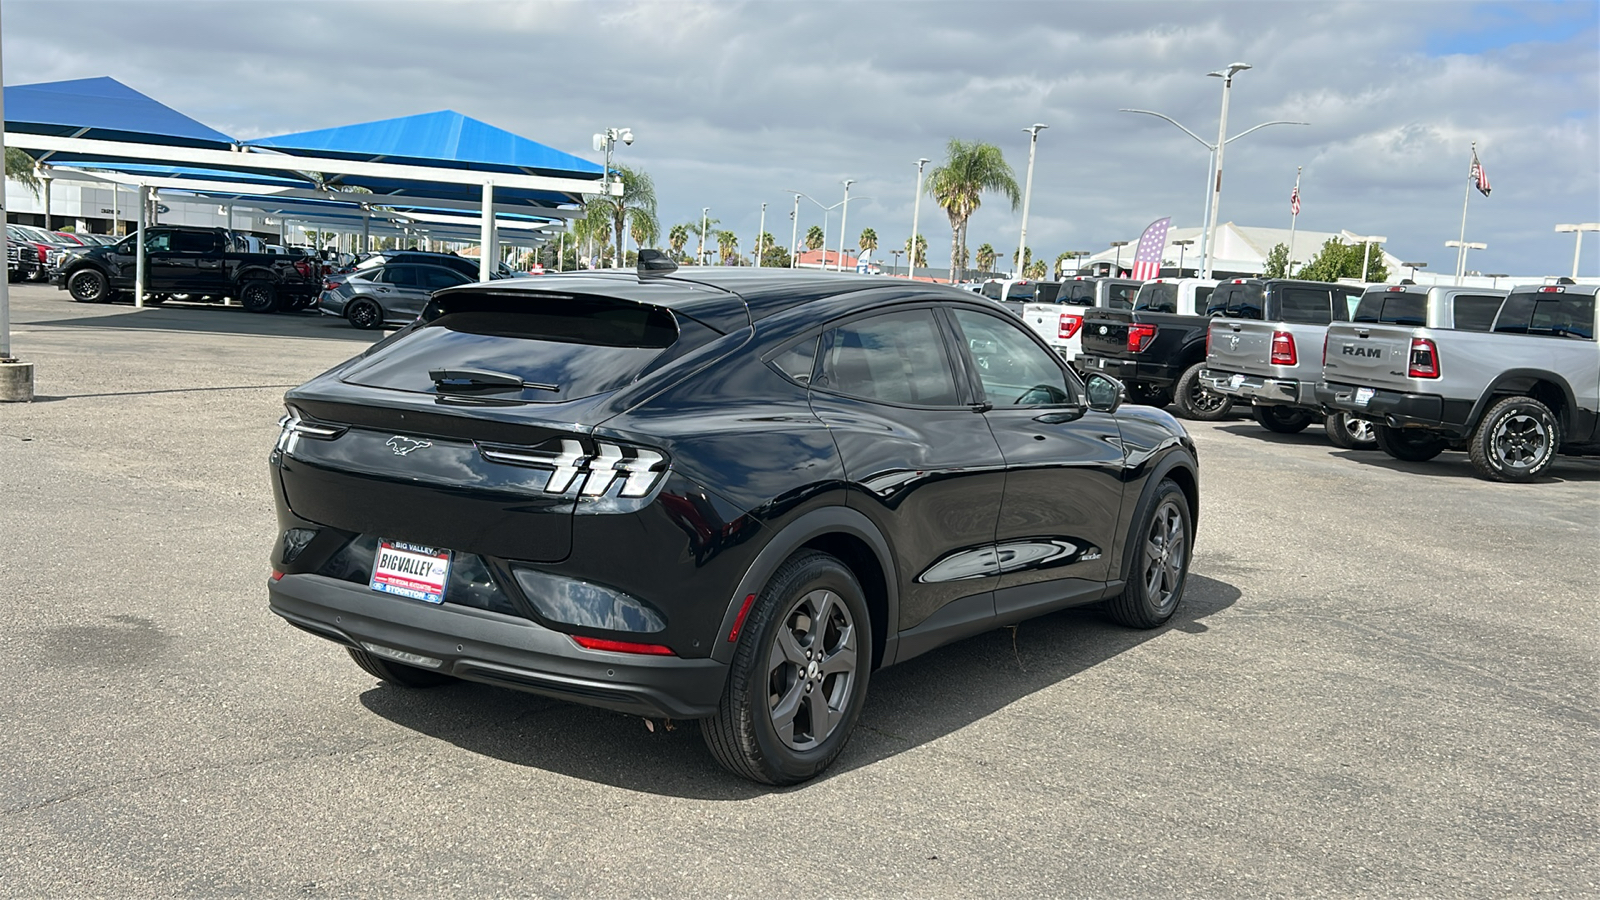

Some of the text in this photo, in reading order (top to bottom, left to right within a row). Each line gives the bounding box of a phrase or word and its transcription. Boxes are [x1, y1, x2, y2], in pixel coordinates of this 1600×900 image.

[1342, 346, 1381, 358] RAM
[396, 541, 434, 555] BIG VALLEY
[379, 553, 433, 577] BIGVALLEY
[385, 585, 426, 599] STOCKTON
